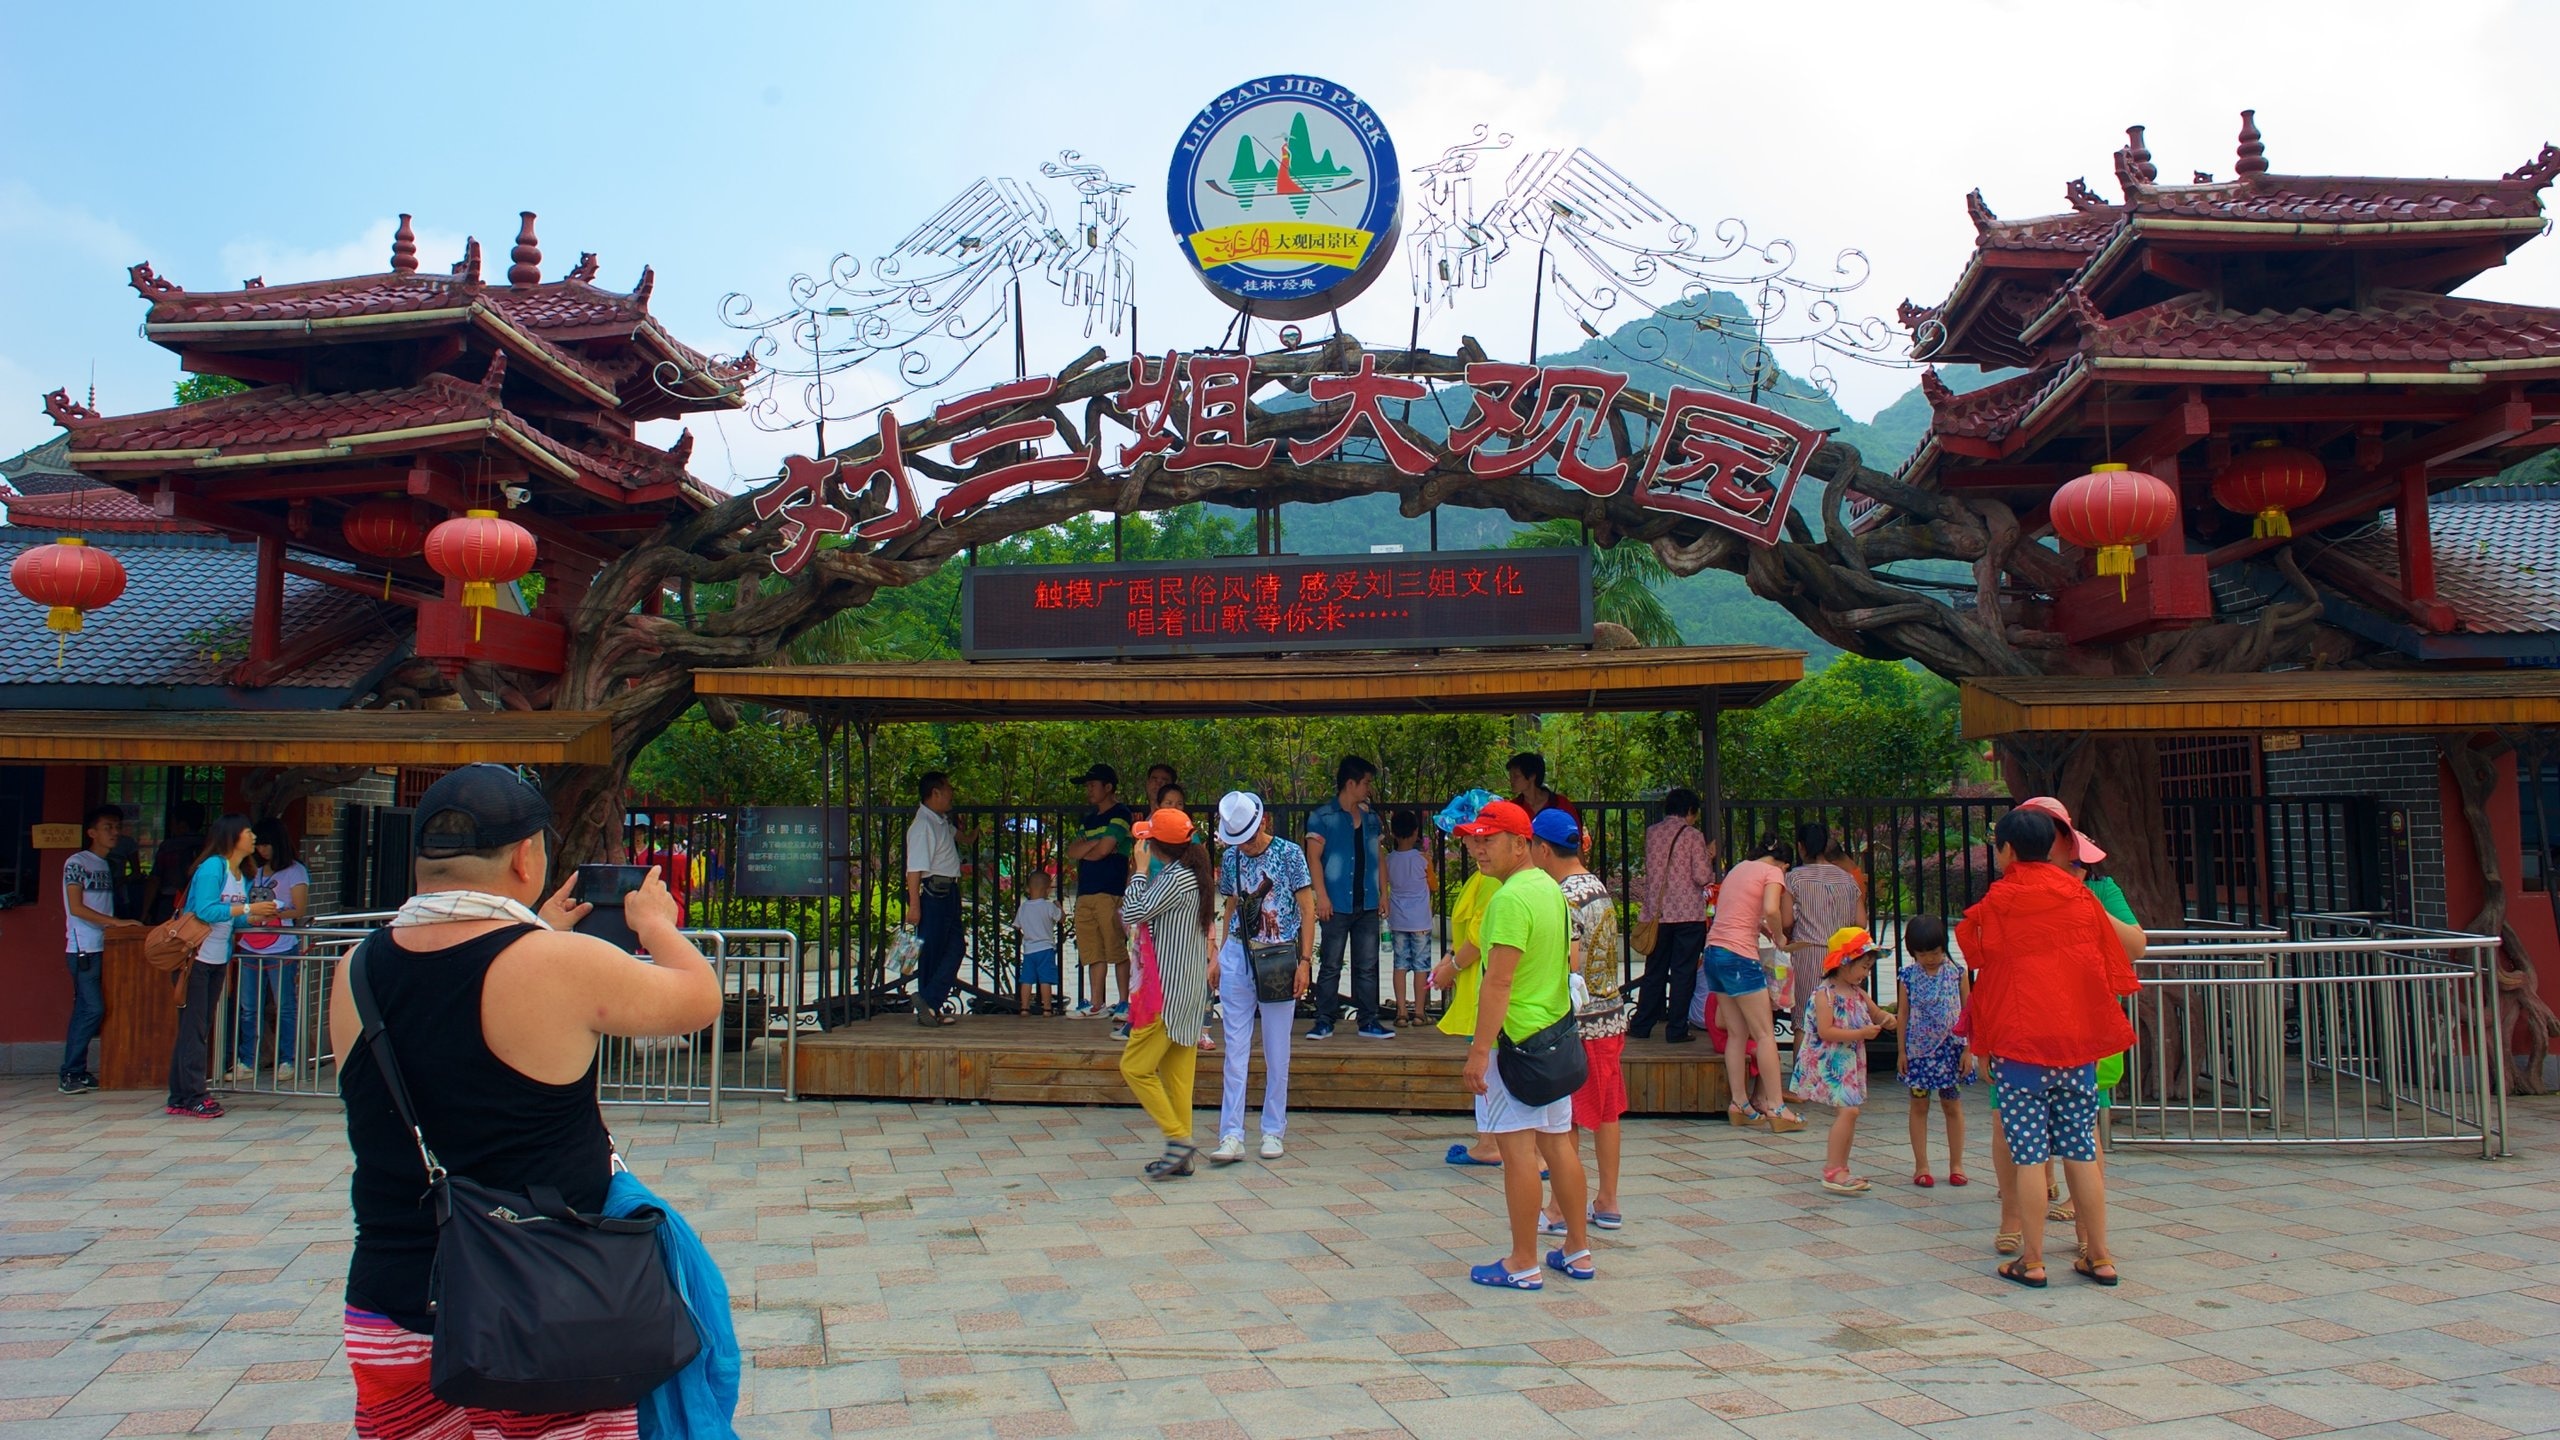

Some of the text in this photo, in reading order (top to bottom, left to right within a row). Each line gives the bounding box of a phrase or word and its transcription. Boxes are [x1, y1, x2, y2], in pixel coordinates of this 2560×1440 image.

[1182, 78, 1386, 154] LIU SAN JIE PARK
[1275, 232, 1360, 250] 大观园景区
[1243, 279, 1316, 292] 桂林·经典
[754, 353, 1827, 576] 刘三姐大观园
[1034, 565, 1524, 609] 触摸广西民俗风情 感受刘三姐文化
[766, 824, 818, 834] 民警提示
